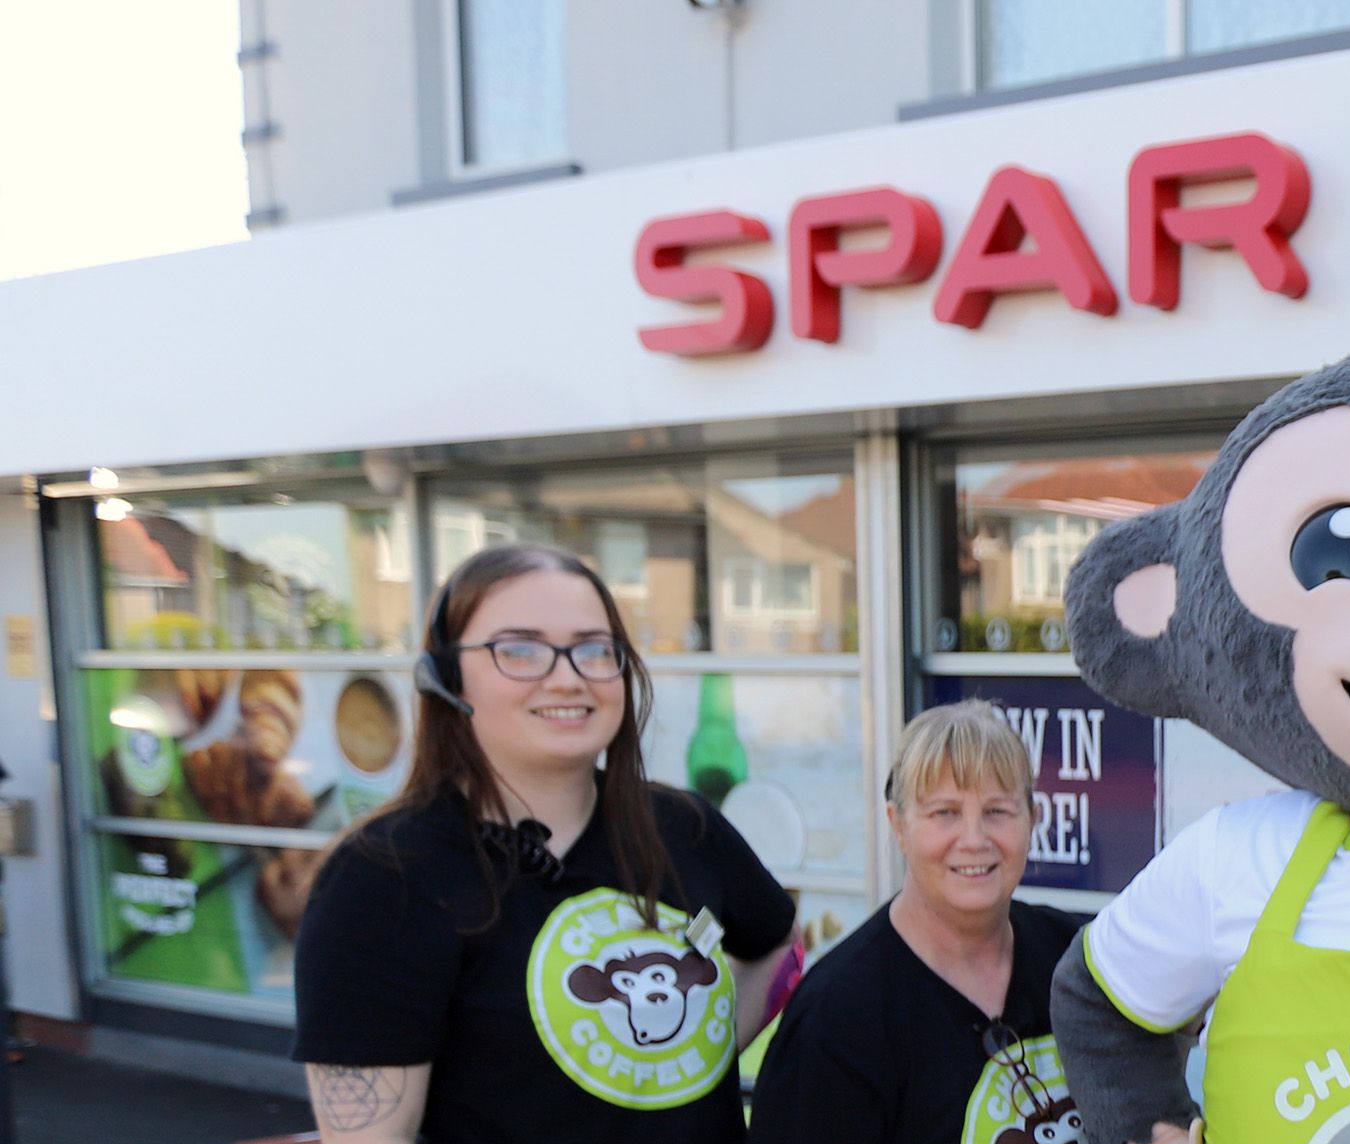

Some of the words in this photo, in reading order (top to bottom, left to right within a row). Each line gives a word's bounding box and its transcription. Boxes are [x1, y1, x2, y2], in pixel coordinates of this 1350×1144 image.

[635, 130, 1313, 357] SPAR
[1057, 708, 1105, 782] IN
[571, 1019, 706, 1087] COFFEE
